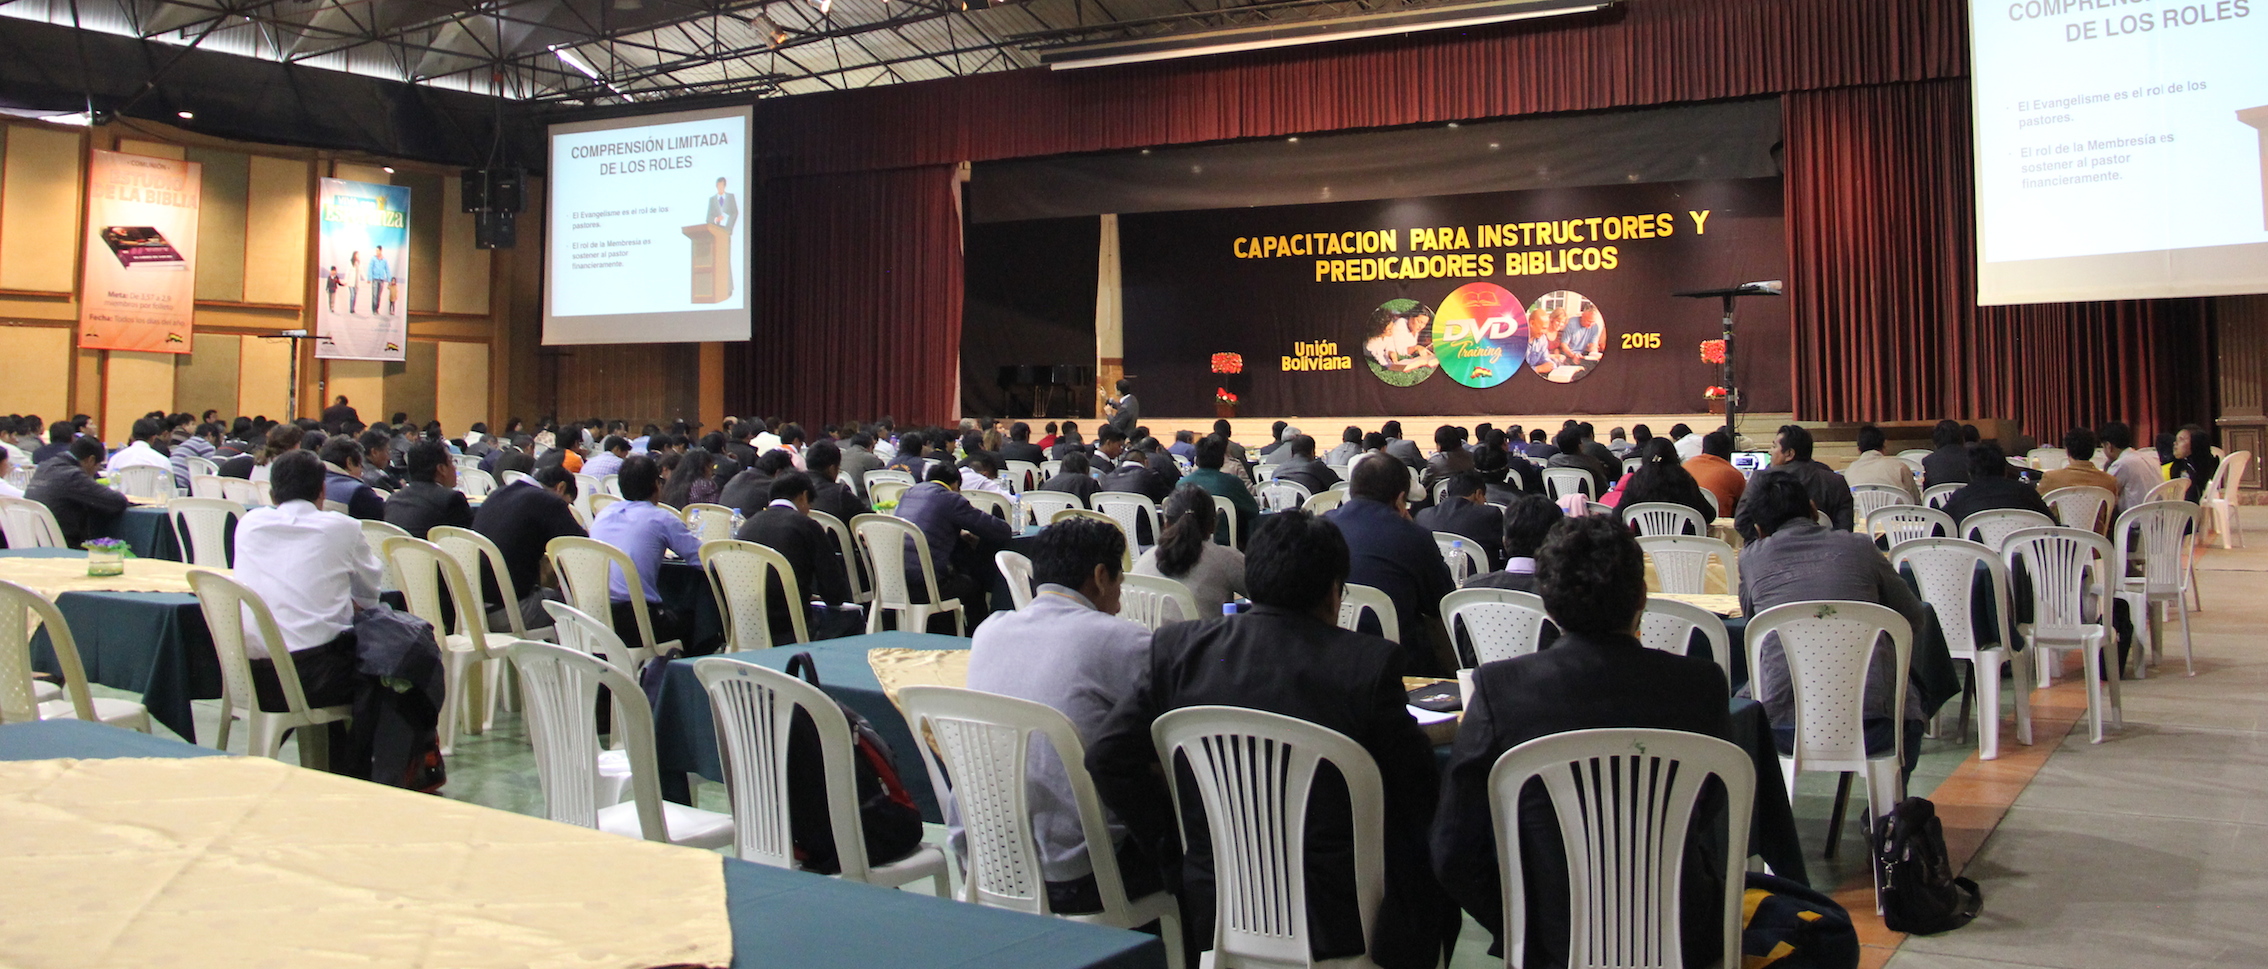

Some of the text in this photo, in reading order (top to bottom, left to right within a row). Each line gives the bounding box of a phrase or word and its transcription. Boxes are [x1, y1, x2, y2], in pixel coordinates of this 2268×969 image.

[2066, 0, 2250, 42] DE LOS ROLES
[2018, 80, 2207, 112] El Evangelisme es el rol de los
[2018, 112, 2074, 130] pastores.
[571, 132, 728, 159] COMPRENSIÓN LIMITADA
[2020, 132, 2174, 158] El rol de la Membresía es
[600, 155, 693, 176] DE LOS ROLES
[2021, 153, 2131, 173] sostener al pastor
[2022, 170, 2123, 189] financieramente.
[91, 182, 198, 209] DE LA BIBLIA
[580, 210, 620, 219] Evangelisme
[580, 241, 589, 249] rol
[1233, 210, 1710, 259] CAPACITACION PARA INSTRUCTORES Y
[608, 250, 629, 258] pastor
[1315, 246, 1618, 282] PREDICADORES BIBLICOS
[1442, 316, 1518, 344] DVD
[1621, 332, 1661, 349] 2015
[1294, 339, 1338, 357] Unión
[1450, 340, 1503, 364] Training
[1281, 355, 1352, 372] Boliviana
